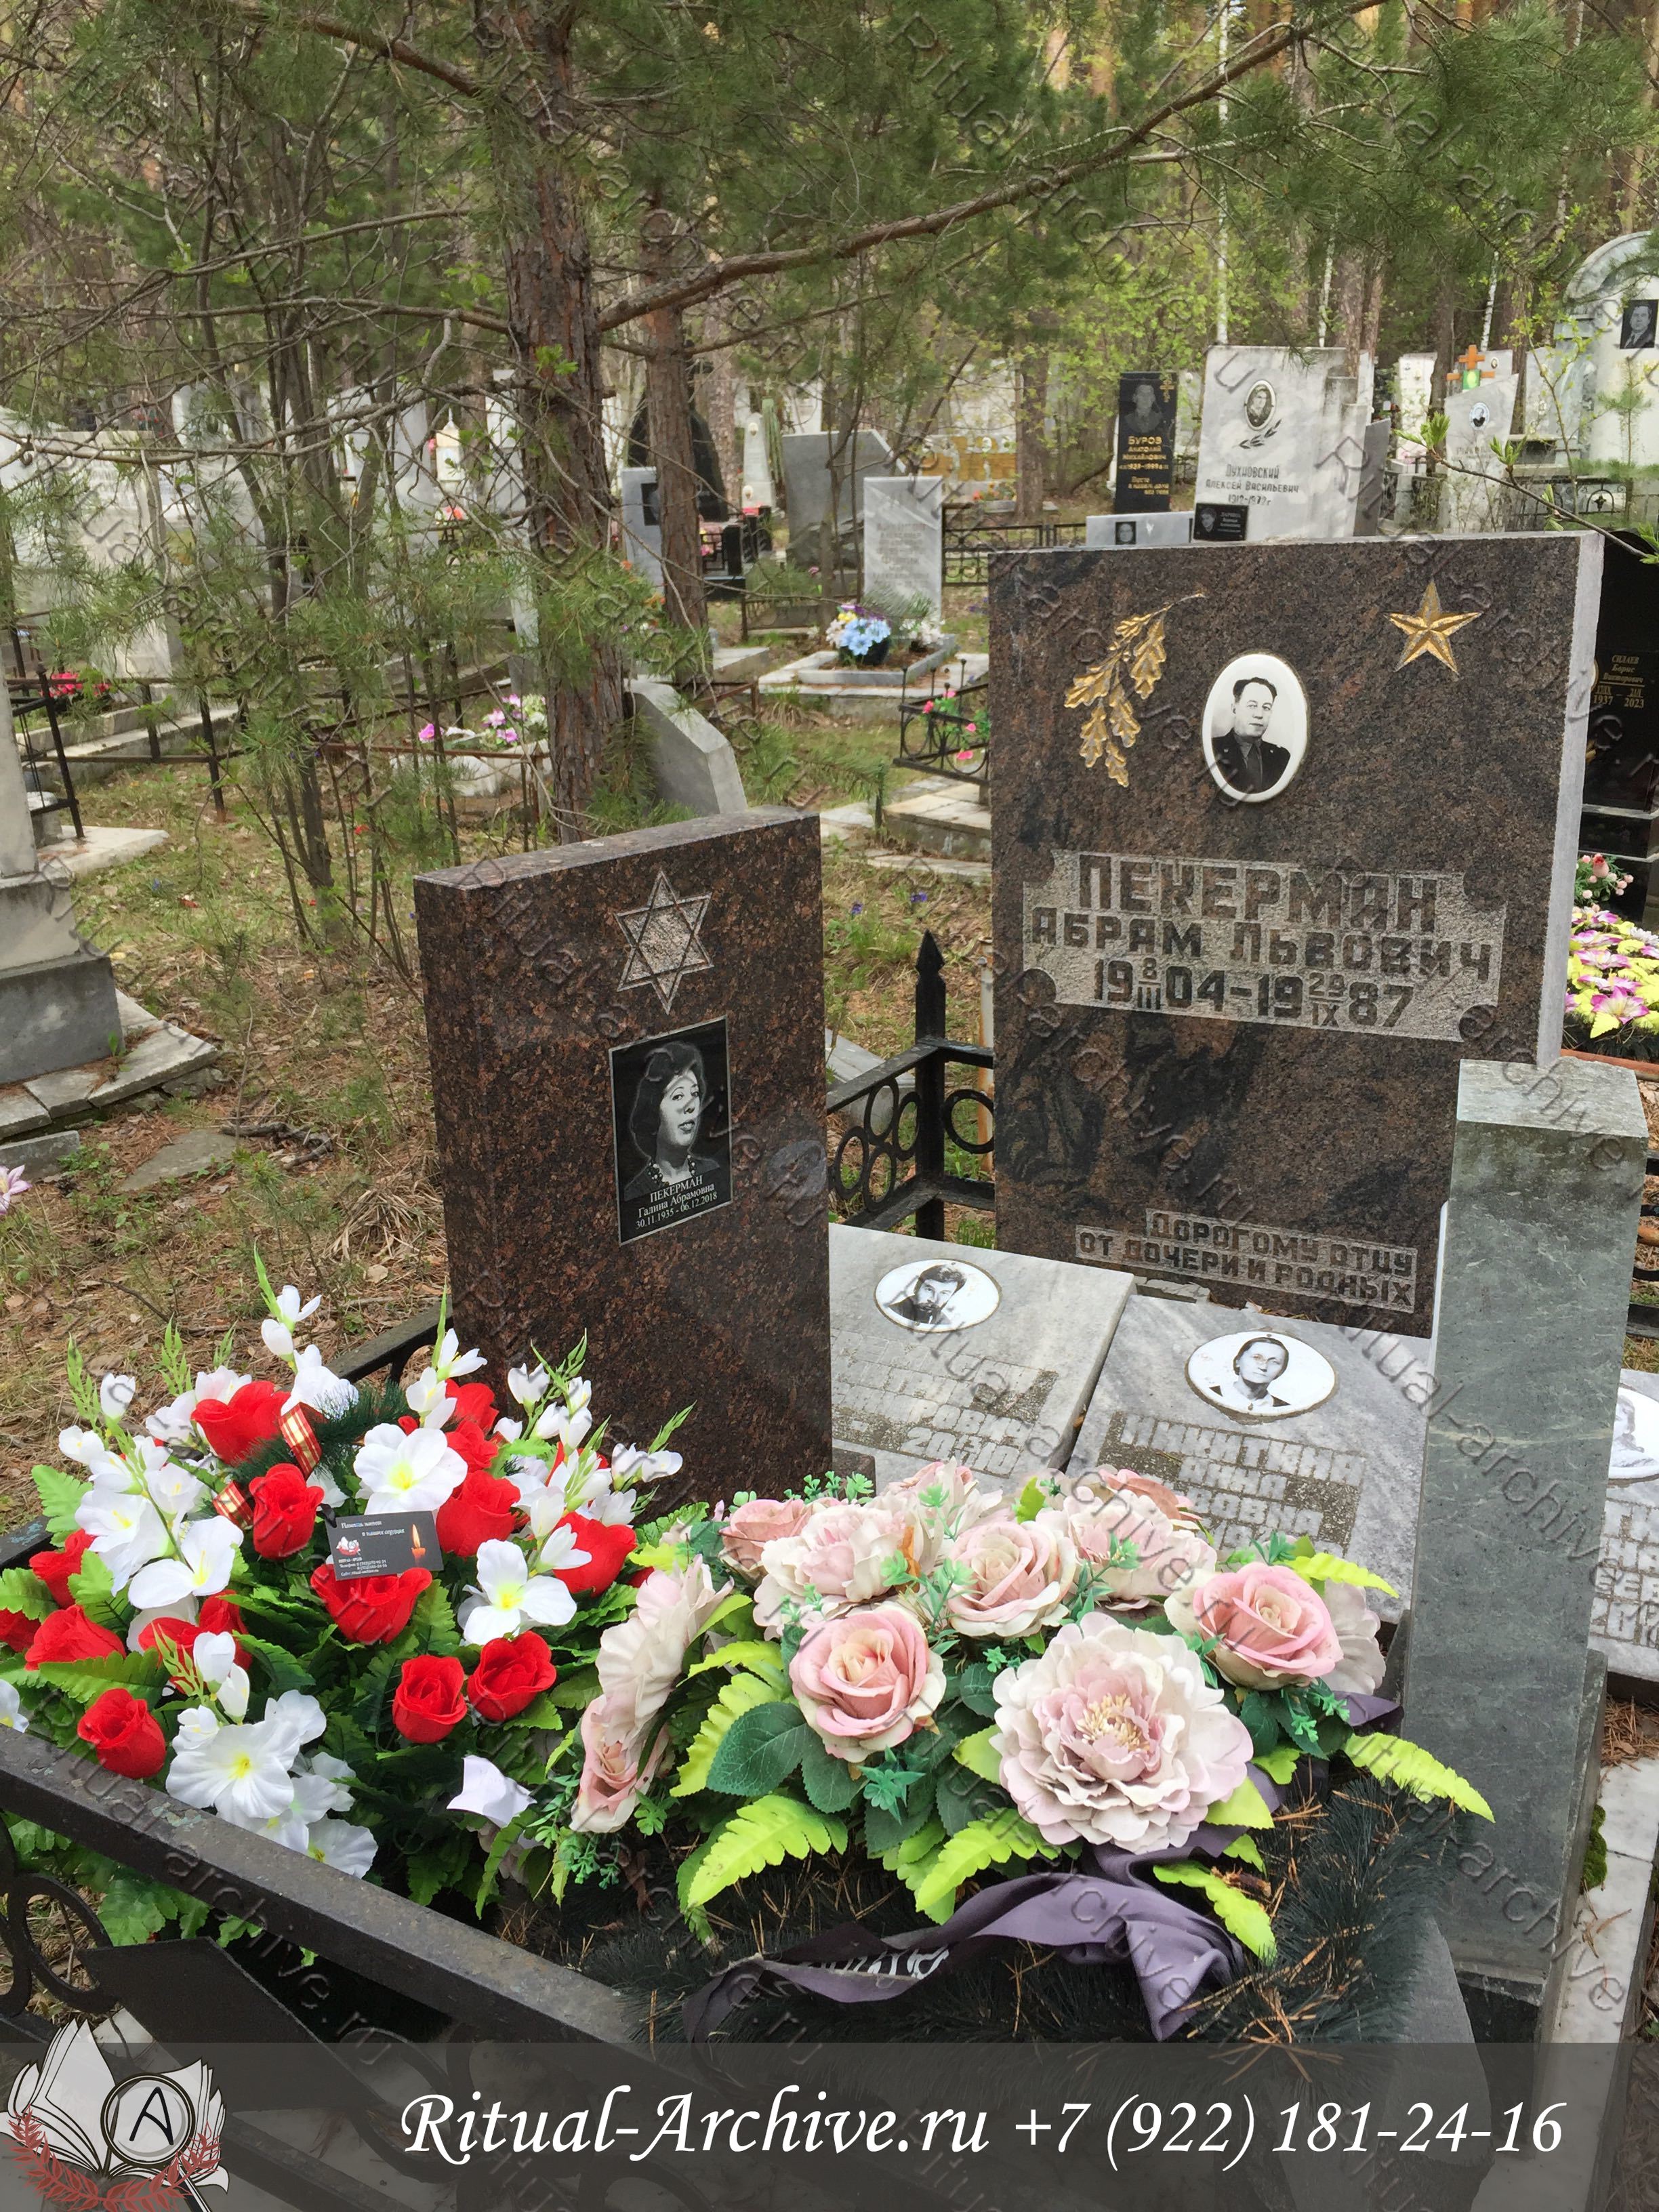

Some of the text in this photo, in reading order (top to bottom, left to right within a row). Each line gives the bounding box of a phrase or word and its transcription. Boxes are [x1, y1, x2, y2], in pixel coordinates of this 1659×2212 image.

[1128, 436, 1162, 445] БУРОВ
[1612, 655, 1640, 664] СИЛАЕВ
[1612, 663, 1635, 673] Борис
[1593, 695, 1614, 705] 1937
[1624, 697, 1644, 708] 2023
[1079, 854, 1437, 933] ПЕКЕРМАН
[1031, 907, 1492, 983] АБРАМ ЛЬВОВИЧ
[638, 1184, 714, 1218] Галина Абрамовна
[651, 1175, 703, 1203] ПЕКЕРМАН
[636, 1208, 674, 1230] 30.11.1935
[680, 1191, 718, 1212] 06.12.2018
[1153, 1212, 1413, 1275] ДОРОГОМУ ОТЦУ
[1080, 1231, 1412, 1307] ОТ ДОЧЕРИ И РОДНЫХ
[1120, 1414, 1366, 1486] НИКИТИНА
[1179, 1456, 1287, 1500] АННА
